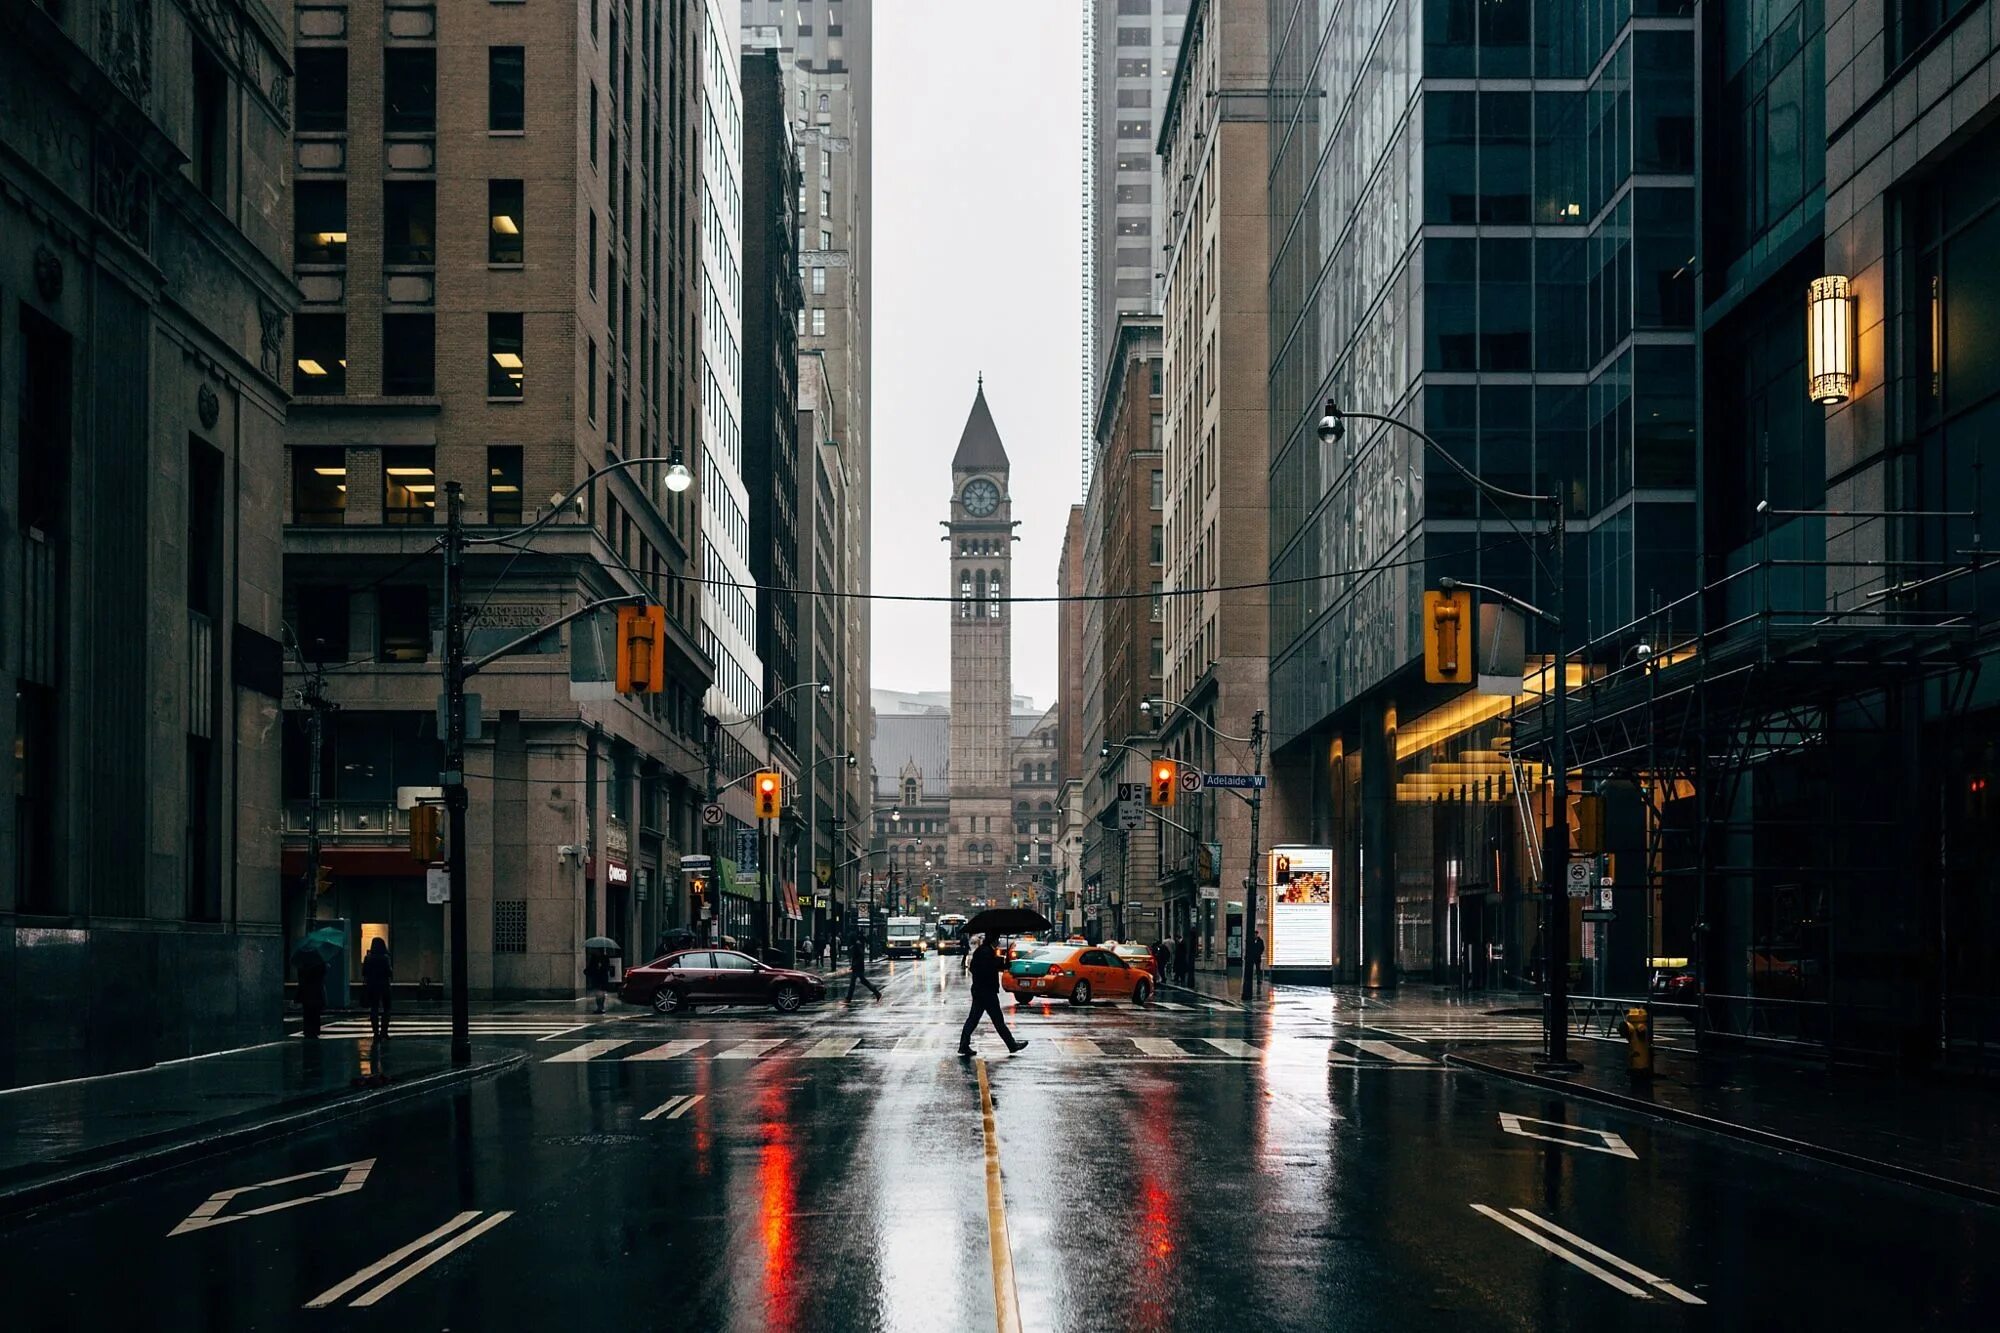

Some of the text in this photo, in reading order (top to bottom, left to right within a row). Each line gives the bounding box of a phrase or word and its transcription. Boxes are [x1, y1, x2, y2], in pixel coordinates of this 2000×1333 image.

[480, 616, 541, 625] ONTARIO
[1207, 776, 1246, 786] Adelaide
[1254, 776, 1263, 786] W
